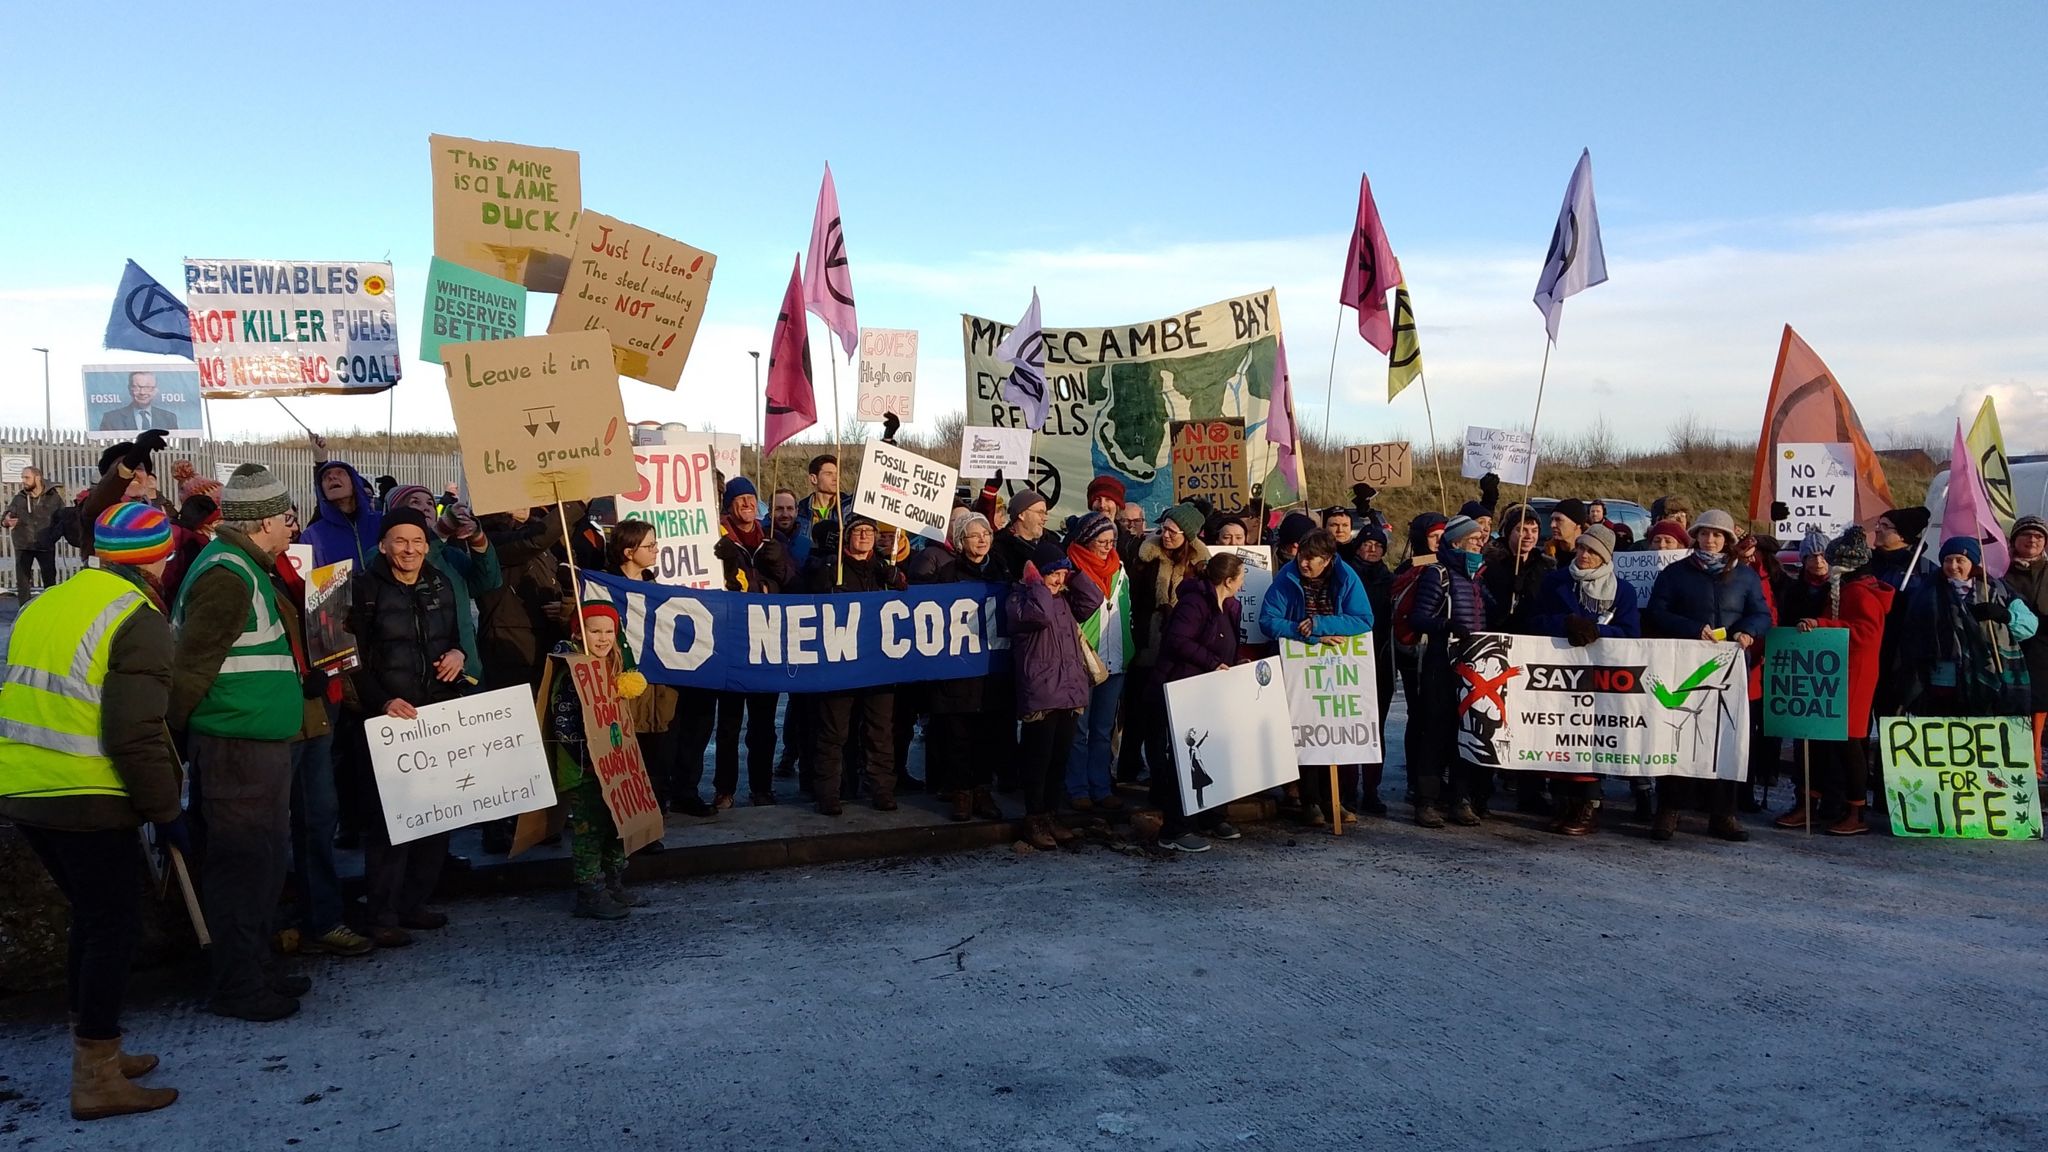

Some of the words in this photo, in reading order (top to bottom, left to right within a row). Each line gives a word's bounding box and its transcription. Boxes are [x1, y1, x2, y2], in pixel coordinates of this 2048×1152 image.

[448, 150, 498, 171] This
[454, 173, 470, 190] is
[497, 176, 558, 202] LAME
[482, 202, 578, 237] DUCK!
[591, 226, 630, 260] Just
[185, 264, 358, 295] RENEWABLES
[582, 260, 607, 280] The
[616, 271, 648, 292] steel
[651, 285, 691, 312] industry
[437, 280, 516, 311] WHITEHAVEN
[579, 283, 608, 304] does
[615, 294, 655, 319] NOT
[655, 315, 684, 328] want
[434, 296, 516, 329] DESERVES
[189, 310, 236, 343] NOT
[242, 310, 327, 342] KILLER
[971, 311, 1207, 365] MECAMBE
[1230, 294, 1270, 340] BAY
[628, 333, 676, 356] coal!
[198, 356, 226, 387] NO
[299, 355, 330, 384] NO
[465, 352, 531, 388] Leave
[542, 352, 557, 375] it
[570, 355, 590, 371] in
[860, 360, 890, 387] High
[894, 371, 912, 382] on
[91, 394, 121, 404] FOSSIL
[161, 393, 185, 403] FOOL
[859, 393, 909, 416] COKE
[484, 450, 517, 474] the
[537, 417, 617, 468] ground!
[1480, 430, 1495, 441] UK
[1499, 432, 1526, 443] STEEL
[1492, 443, 1508, 451] WANT
[1174, 445, 1239, 464] FUTURE
[1350, 442, 1409, 464] DIRTY
[1508, 454, 1530, 464] NEW
[874, 450, 908, 474] FOSSIL
[913, 464, 946, 488] FUELS
[1190, 462, 1231, 473] WITH
[1480, 460, 1502, 470] COAL
[1791, 464, 1815, 478] NO
[622, 453, 709, 504] STOP
[883, 471, 909, 490] MUST
[913, 483, 939, 502] STAY
[1179, 474, 1238, 489] FOSSIL
[1792, 485, 1835, 498] NEW
[864, 490, 876, 505] IN
[881, 495, 901, 514] THE
[905, 504, 945, 530] GROUND
[1795, 505, 1831, 517] OIL
[1779, 522, 1791, 533] OR
[1617, 554, 1678, 568] CUMBRIANS
[747, 601, 860, 665] NEW
[880, 597, 1010, 660] COAL
[1318, 656, 1342, 665] SAFE
[1771, 650, 1840, 675] #NO
[1304, 665, 1326, 689] IT
[1336, 664, 1358, 686] IN
[1532, 668, 1584, 689] SAY
[1593, 670, 1634, 691] NO
[1770, 676, 1840, 697] NEW
[1312, 695, 1362, 718] THE
[1571, 695, 1594, 707] TO
[1770, 697, 1841, 718] COAL
[381, 726, 394, 745] 9
[400, 719, 450, 743] million
[458, 707, 512, 727] tonnes
[1521, 712, 1565, 725] WEST
[1570, 713, 1648, 728] CUMBRIA
[448, 745, 476, 768] per
[482, 733, 524, 757] year
[1556, 734, 1617, 748] MINING
[1888, 721, 2029, 768] REBEL
[1518, 750, 1543, 761] SAY
[1546, 751, 1570, 762] YES
[1575, 752, 1591, 762] TO
[1595, 752, 1640, 764] GREEN
[1644, 754, 1677, 765] JOBS
[1939, 771, 1981, 791] FOR
[1897, 792, 2008, 836] LIFE
